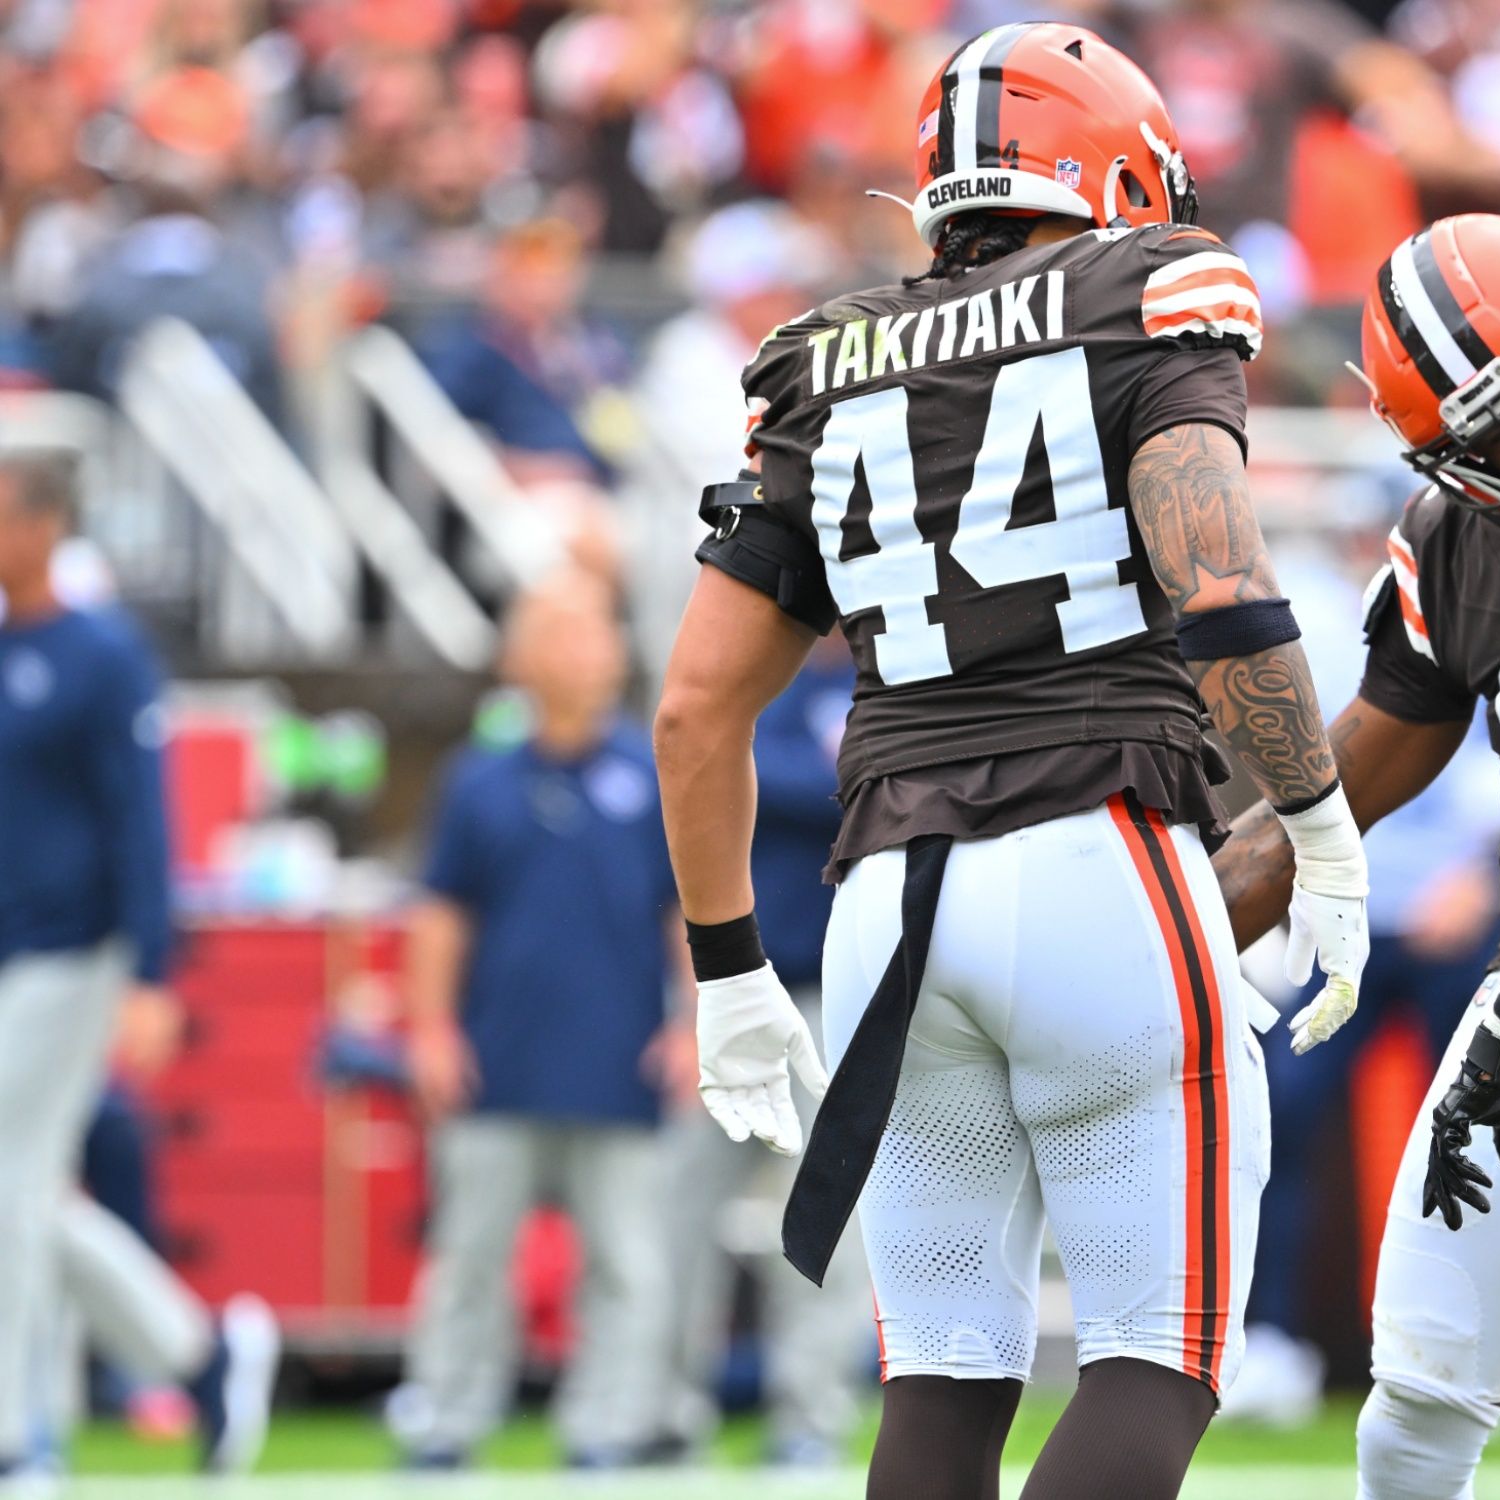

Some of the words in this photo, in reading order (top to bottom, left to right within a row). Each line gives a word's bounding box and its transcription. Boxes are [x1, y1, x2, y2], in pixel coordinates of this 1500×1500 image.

[928, 177, 1012, 209] CLEVELAND
[808, 270, 1065, 396] TAKITAKI
[811, 346, 1149, 686] 44
